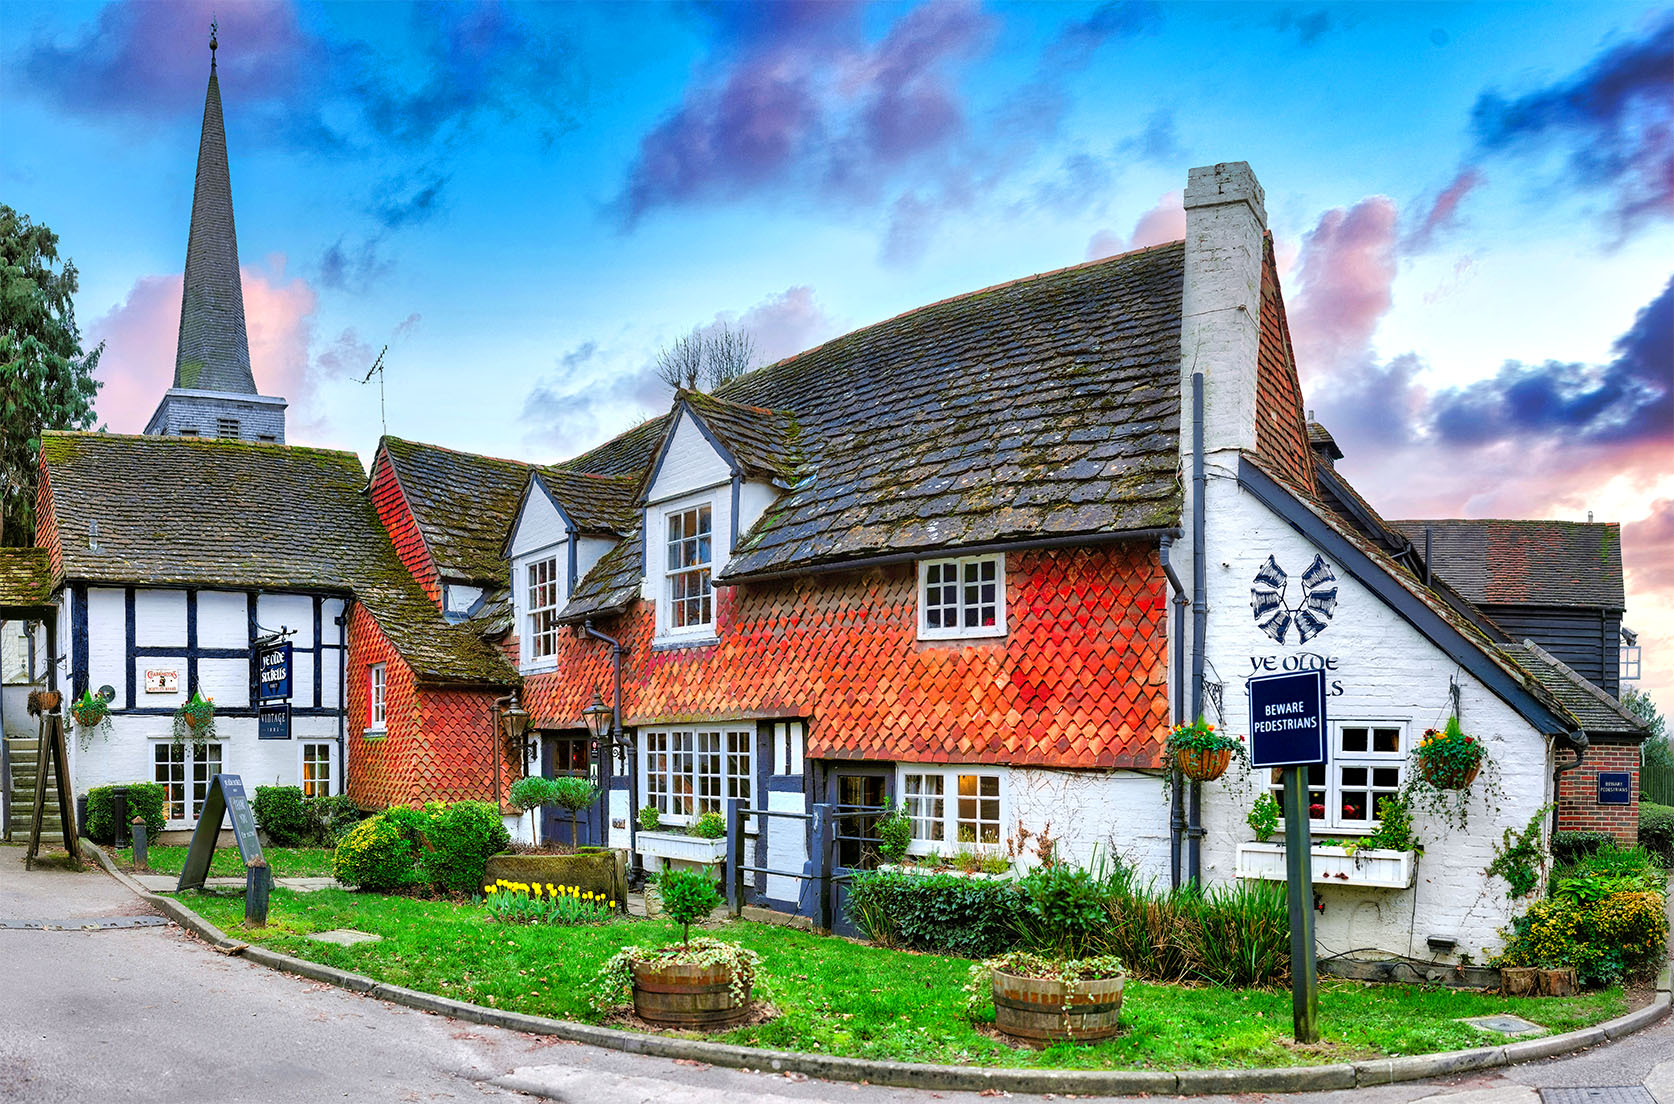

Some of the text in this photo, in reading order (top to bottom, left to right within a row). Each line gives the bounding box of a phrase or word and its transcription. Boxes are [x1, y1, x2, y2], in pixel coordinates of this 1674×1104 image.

[1265, 701, 1304, 716] BEWARE
[260, 712, 286, 725] VINTAGE
[1254, 716, 1317, 733] PEDESTRIANS
